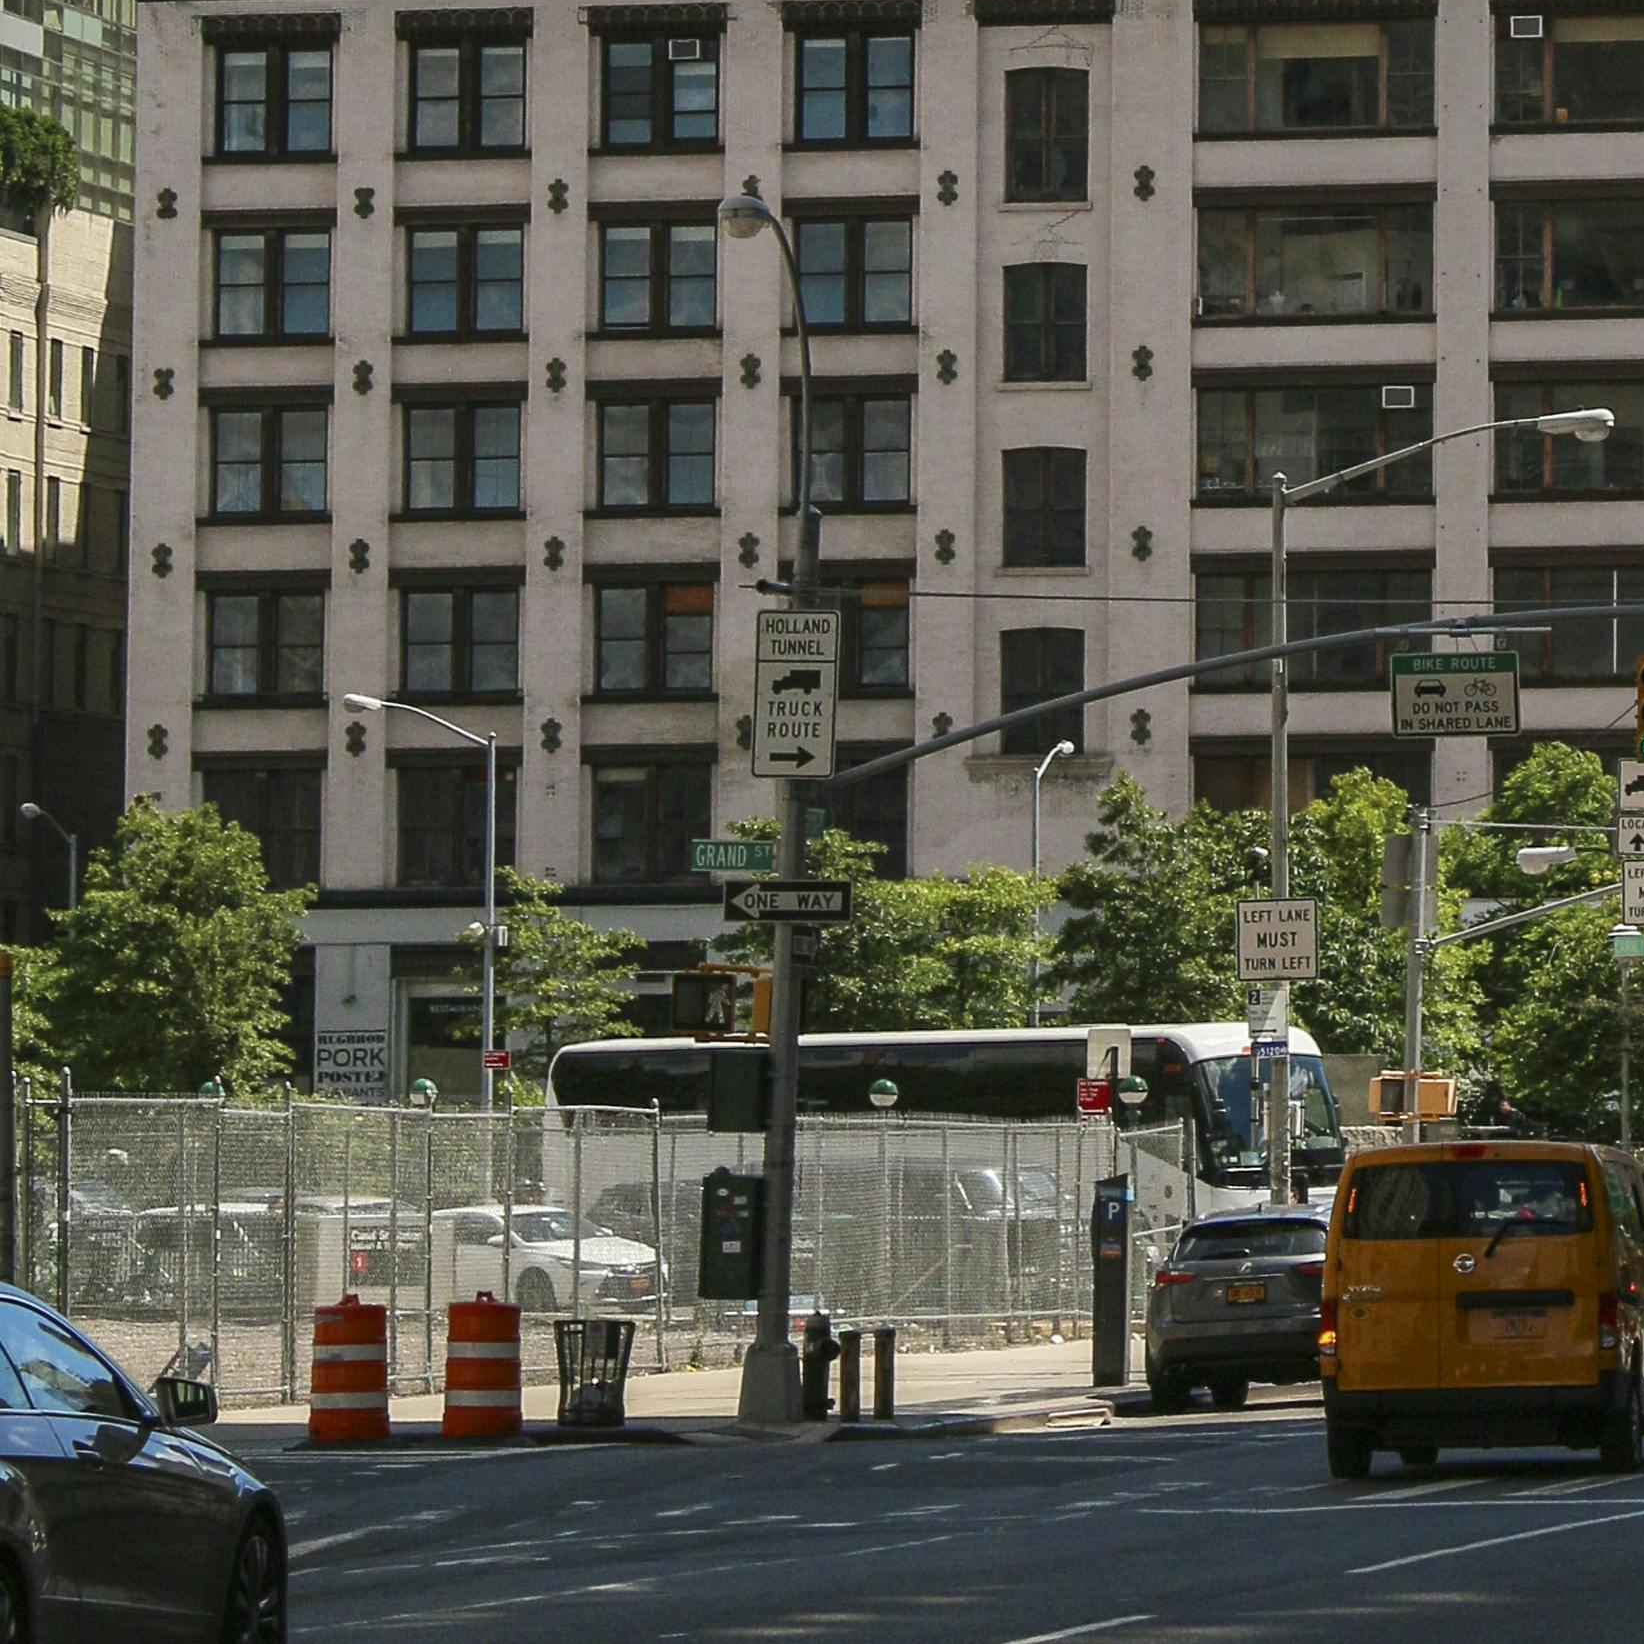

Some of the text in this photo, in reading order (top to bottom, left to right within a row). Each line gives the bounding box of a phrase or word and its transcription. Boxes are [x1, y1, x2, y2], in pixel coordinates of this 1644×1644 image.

[765, 618, 831, 634] HOLLAND
[770, 639, 825, 656] TUNNEL
[1413, 657, 1496, 671] BIKE ROUTE
[767, 700, 823, 717] TRUCK
[1412, 700, 1499, 715] DO NOT PASS
[767, 721, 821, 738] ROUTE
[1401, 716, 1512, 730] IN SHARED LANE
[695, 844, 771, 867] GRAND ST
[744, 893, 834, 910] ONE WAY
[1243, 909, 1311, 924] LEFT LANE
[1257, 931, 1298, 948] MUST
[1244, 956, 1311, 971] TURN LEFT
[1251, 991, 1258, 1004] 2
[317, 1047, 385, 1067] PORK
[1109, 1202, 1120, 1220] P
